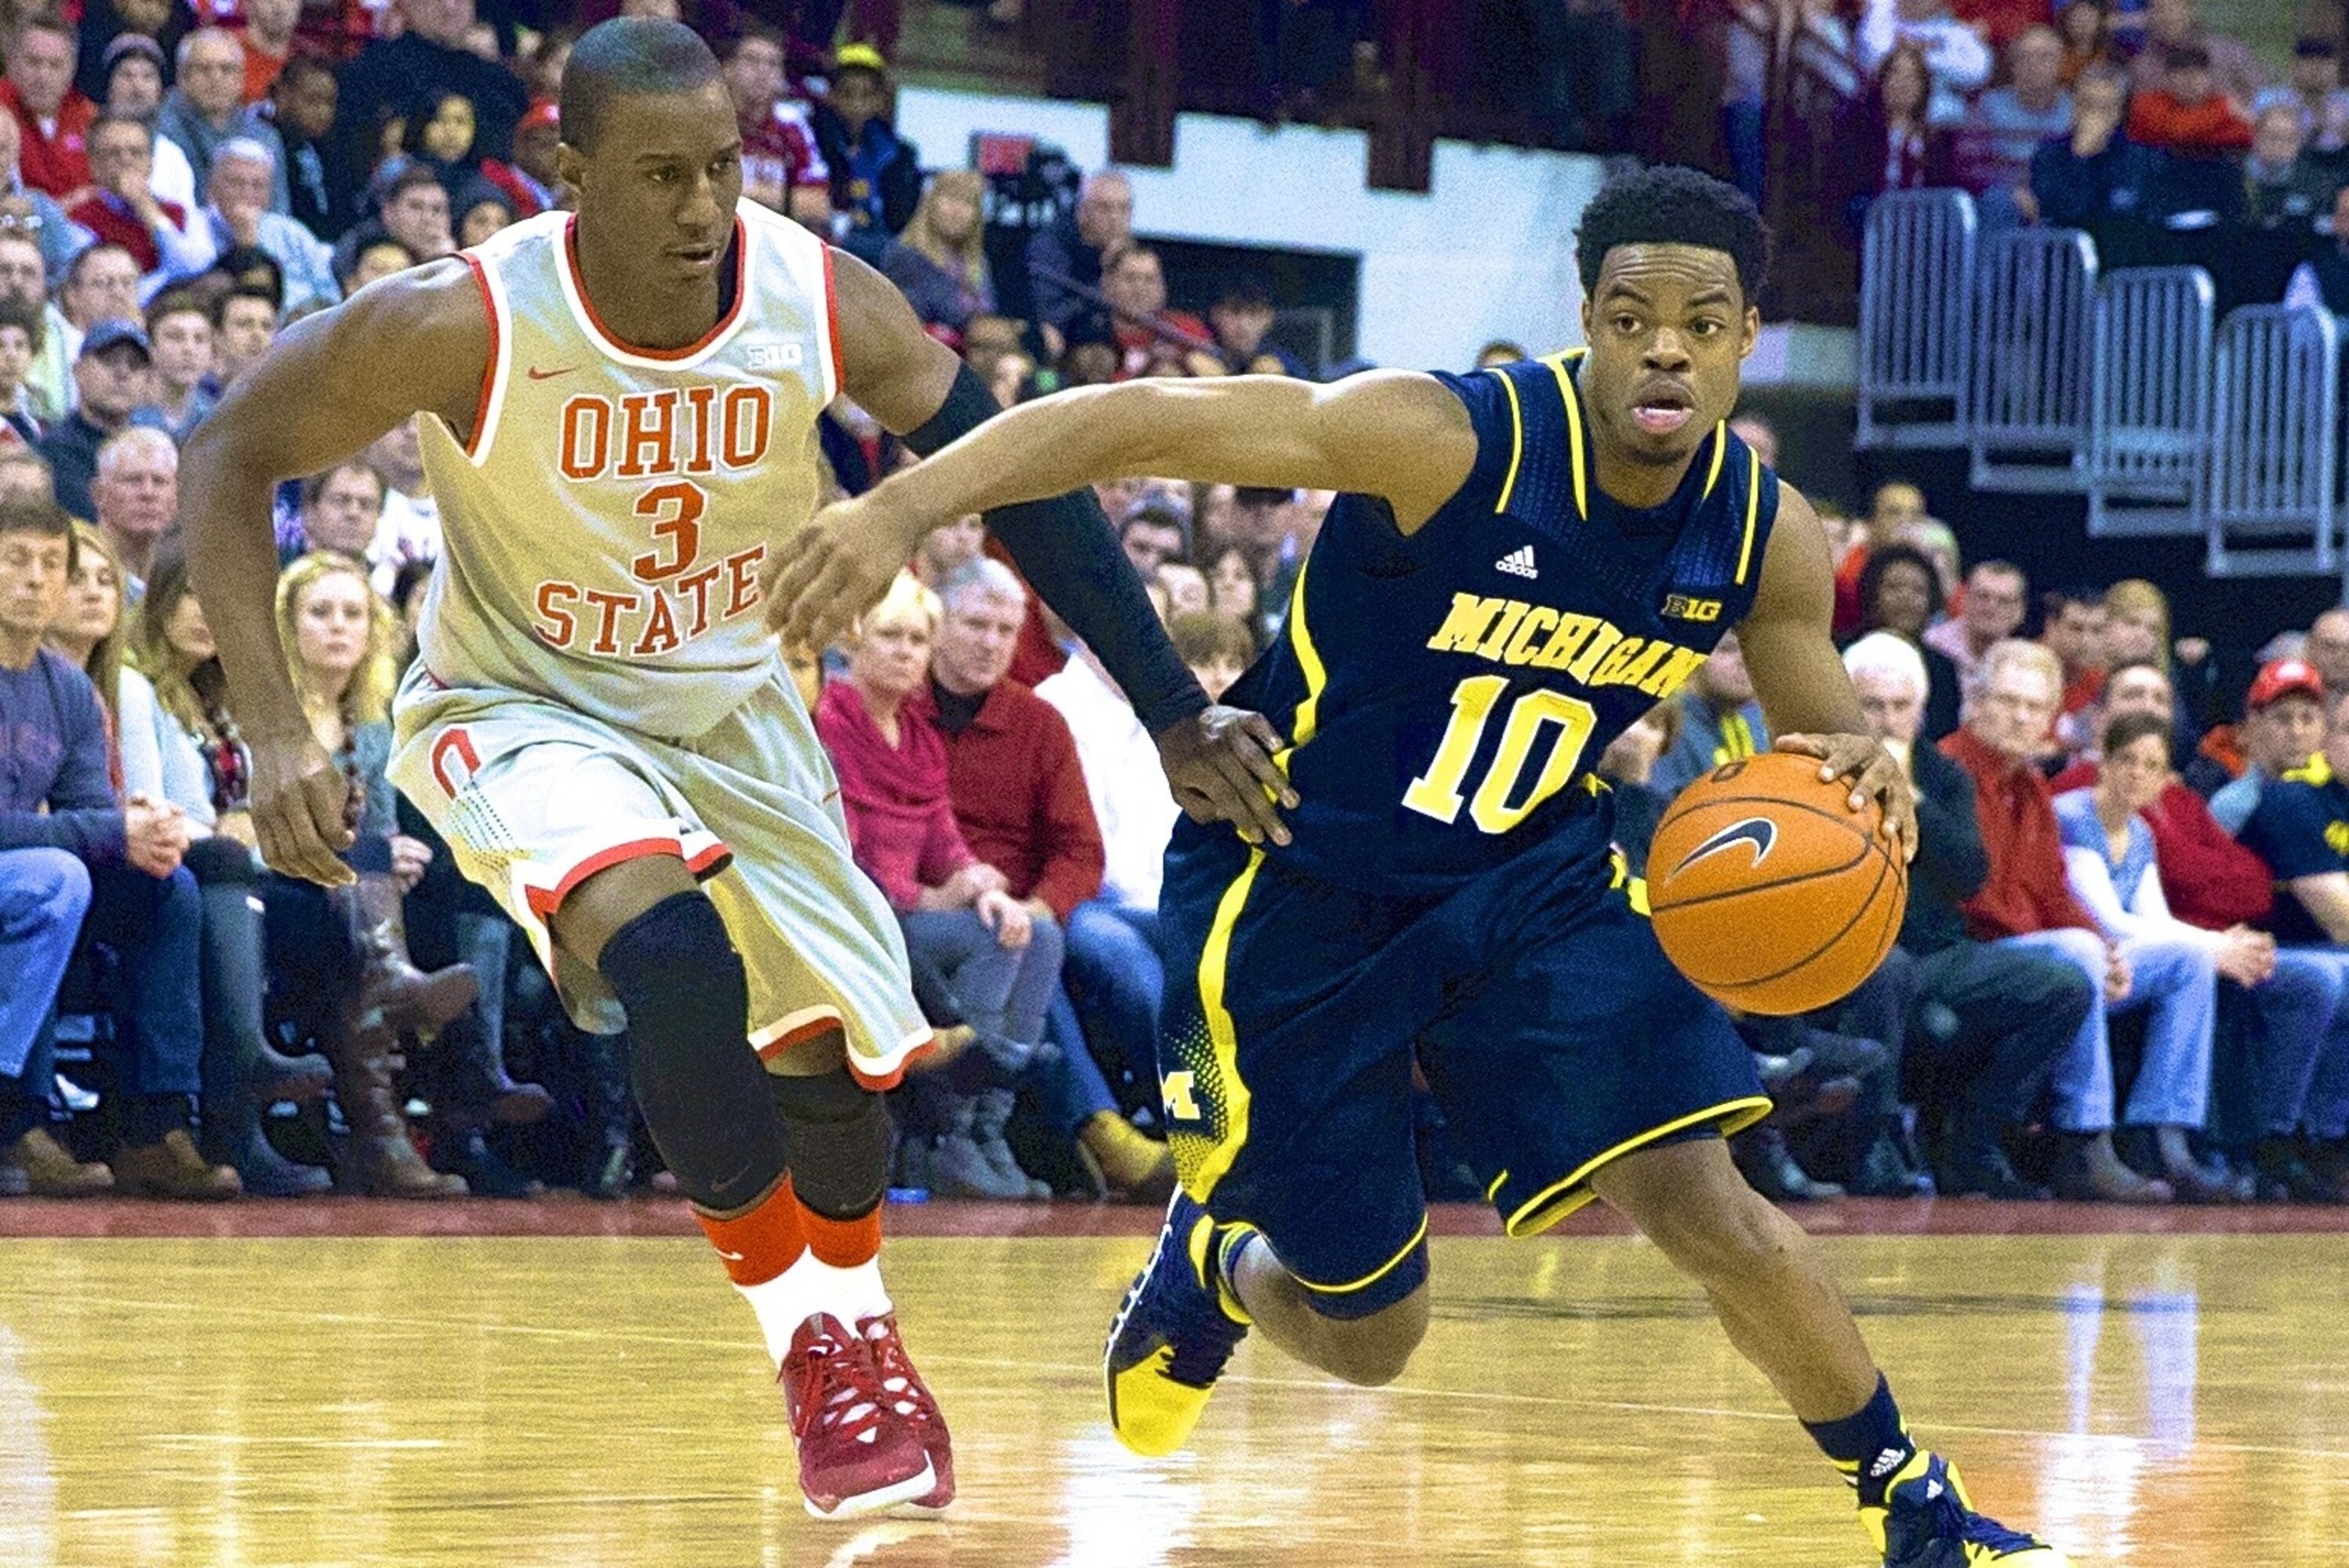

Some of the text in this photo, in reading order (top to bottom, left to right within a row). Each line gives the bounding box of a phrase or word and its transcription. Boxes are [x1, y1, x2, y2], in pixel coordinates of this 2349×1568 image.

[557, 383, 774, 482] OHIO
[632, 478, 709, 582] 3
[1495, 561, 1538, 579] adidas
[533, 541, 767, 657] STATE
[1426, 592, 1711, 699] MICHIGAN
[1401, 674, 1597, 835] 10
